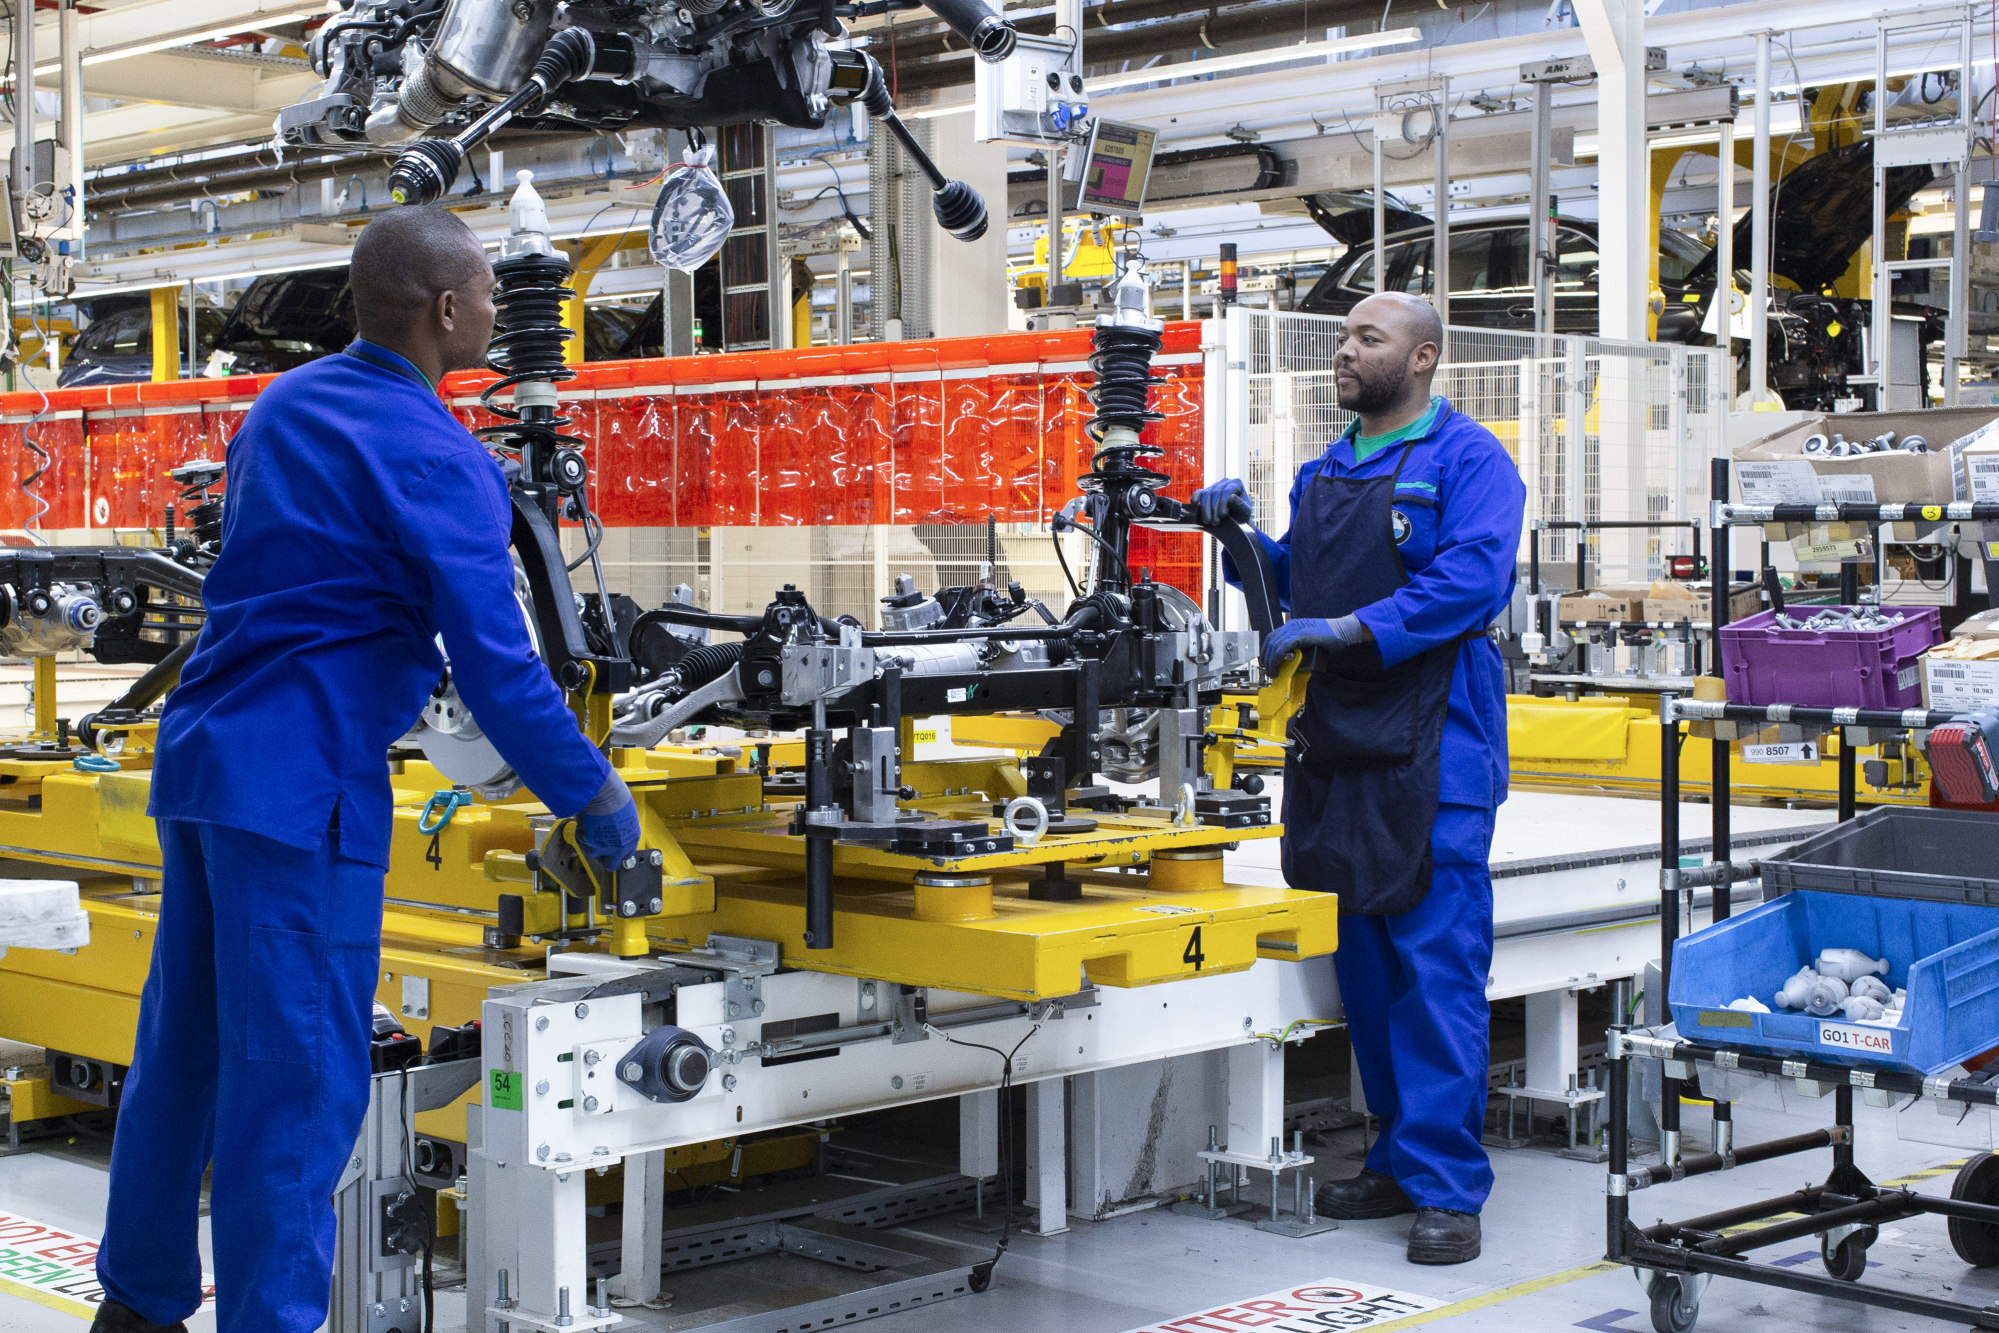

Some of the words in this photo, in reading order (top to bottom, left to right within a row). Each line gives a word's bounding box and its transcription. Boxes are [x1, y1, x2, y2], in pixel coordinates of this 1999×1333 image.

[1927, 507, 1936, 518] 3
[1812, 545, 1837, 553] 2959573
[914, 732, 936, 741] TQ016
[1750, 748, 1764, 756] 990
[1766, 746, 1790, 756] 8507
[425, 832, 443, 872] 4
[1182, 925, 1205, 972] 4
[1852, 1032, 1891, 1050] T-CAR
[494, 1073, 511, 1092] 54
